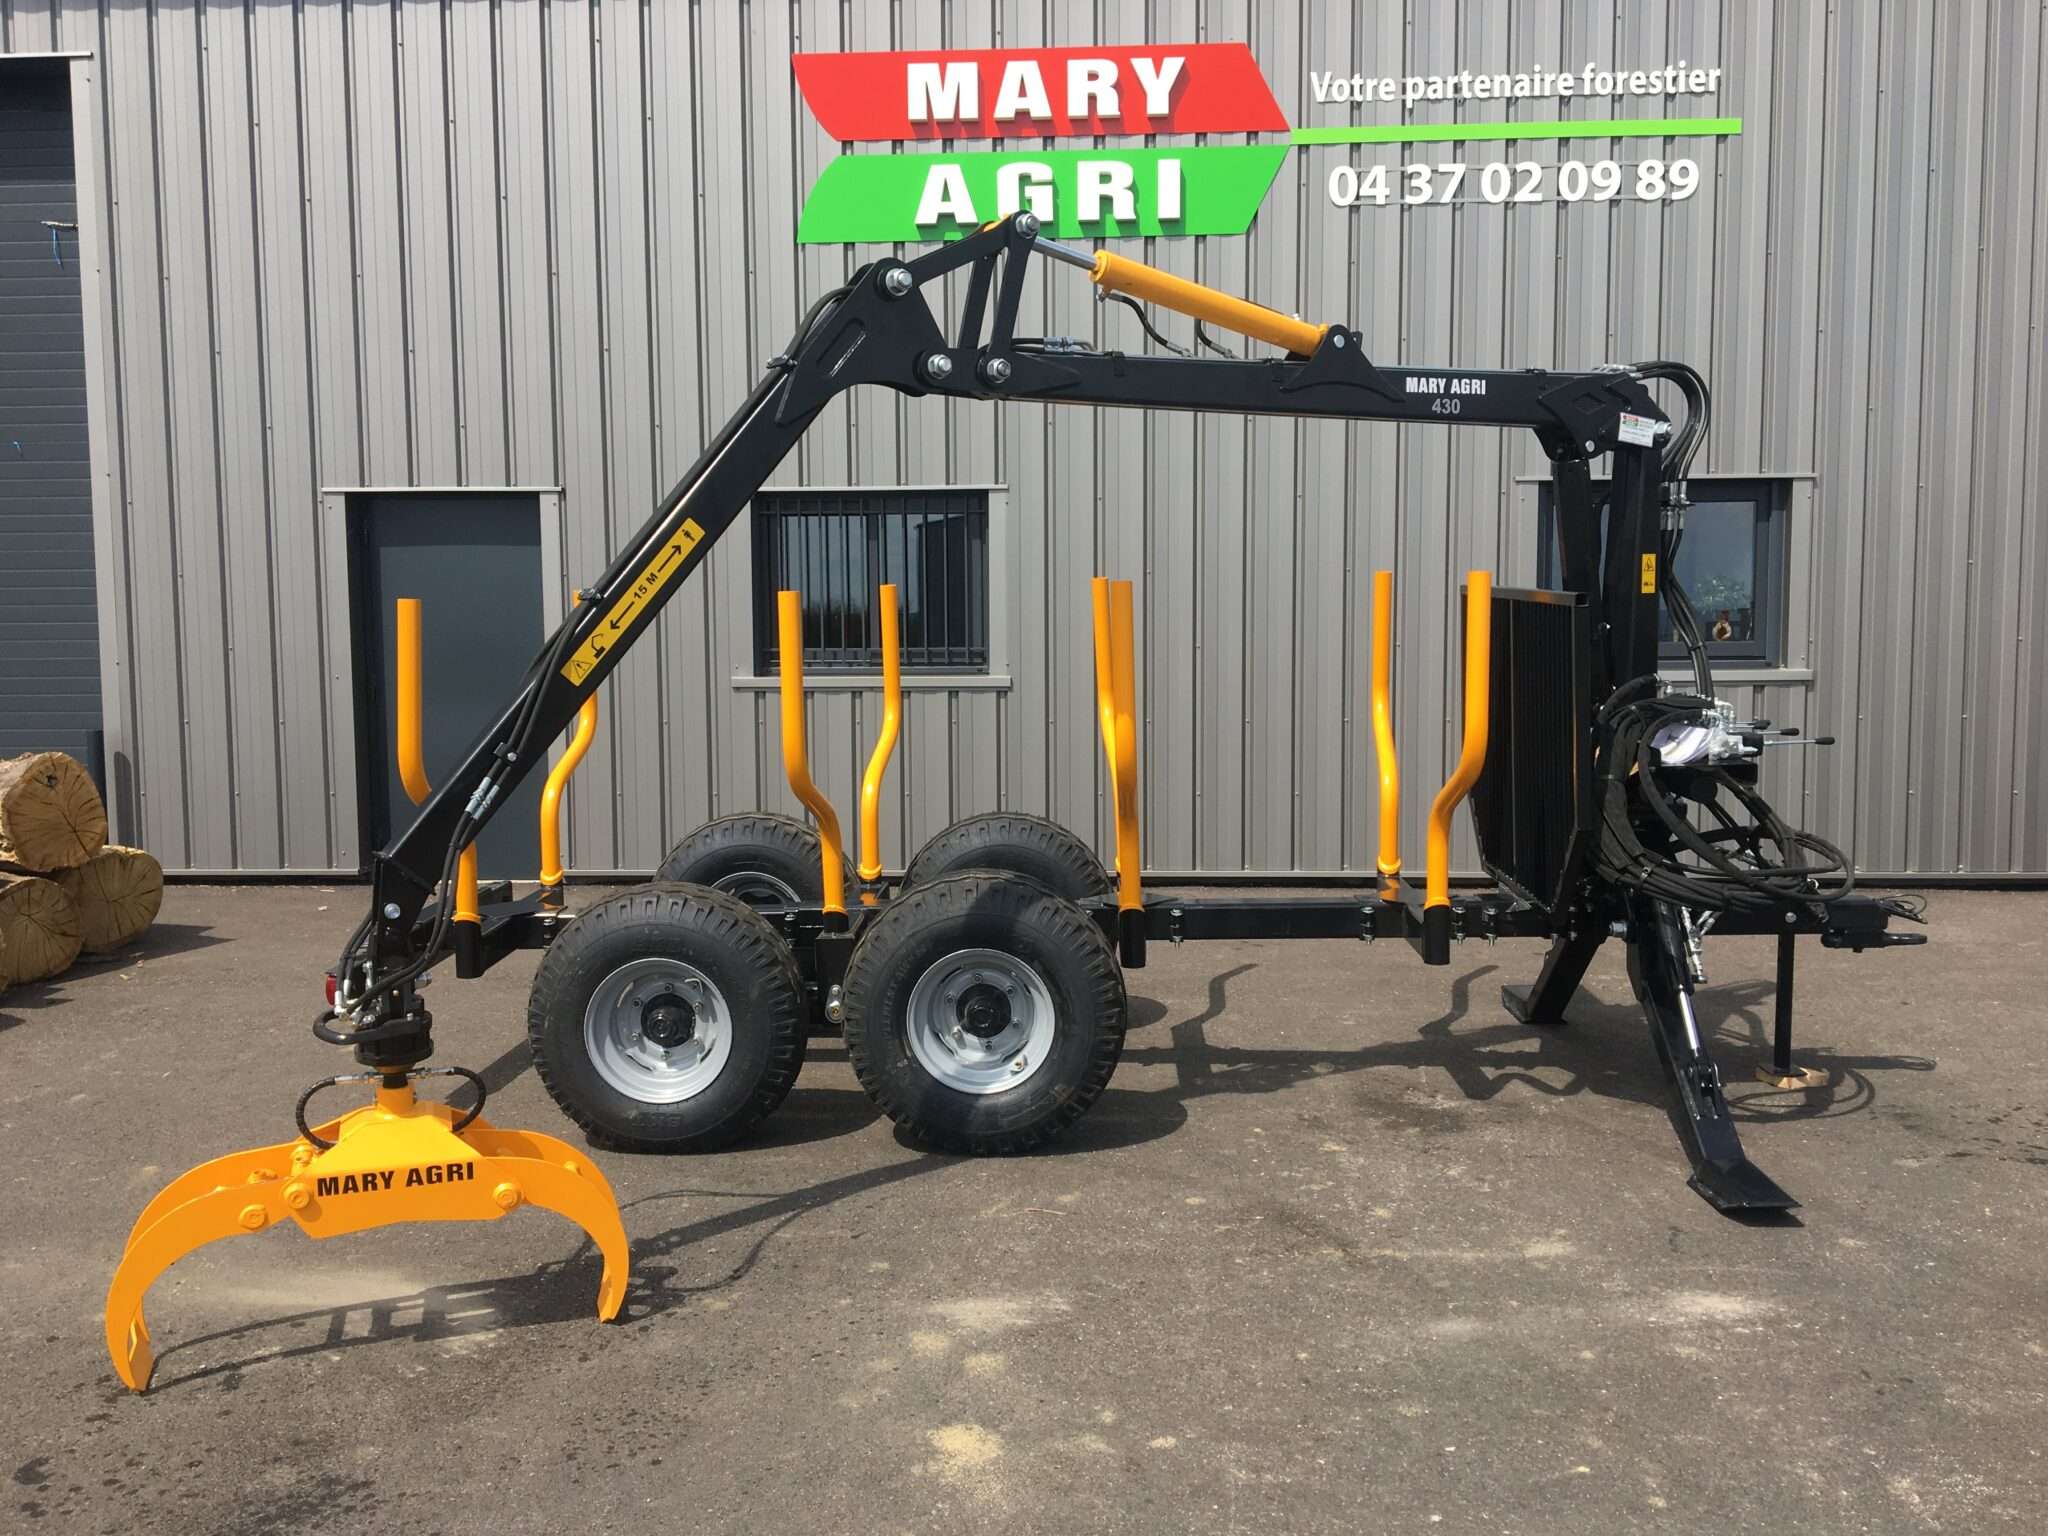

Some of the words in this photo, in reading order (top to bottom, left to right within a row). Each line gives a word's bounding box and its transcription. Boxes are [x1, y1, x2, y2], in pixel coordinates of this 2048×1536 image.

[907, 56, 1186, 121] MARY
[1310, 71, 1396, 102] Votre
[1405, 65, 1575, 108] partenaire
[1582, 61, 1721, 96] forestier
[914, 158, 1182, 226] AGRI
[1328, 165, 1390, 206] 04
[1404, 163, 1466, 204] 37
[1481, 161, 1543, 203] 02
[1558, 160, 1622, 201] 09
[1635, 159, 1699, 200] 89
[1405, 377, 1447, 394] MARY
[1450, 378, 1486, 395] AGRI
[1431, 398, 1461, 414] 430
[633, 584, 648, 600] 15
[646, 572, 658, 585] M
[317, 1170, 395, 1197] MARY
[405, 1162, 474, 1187] AGRI
